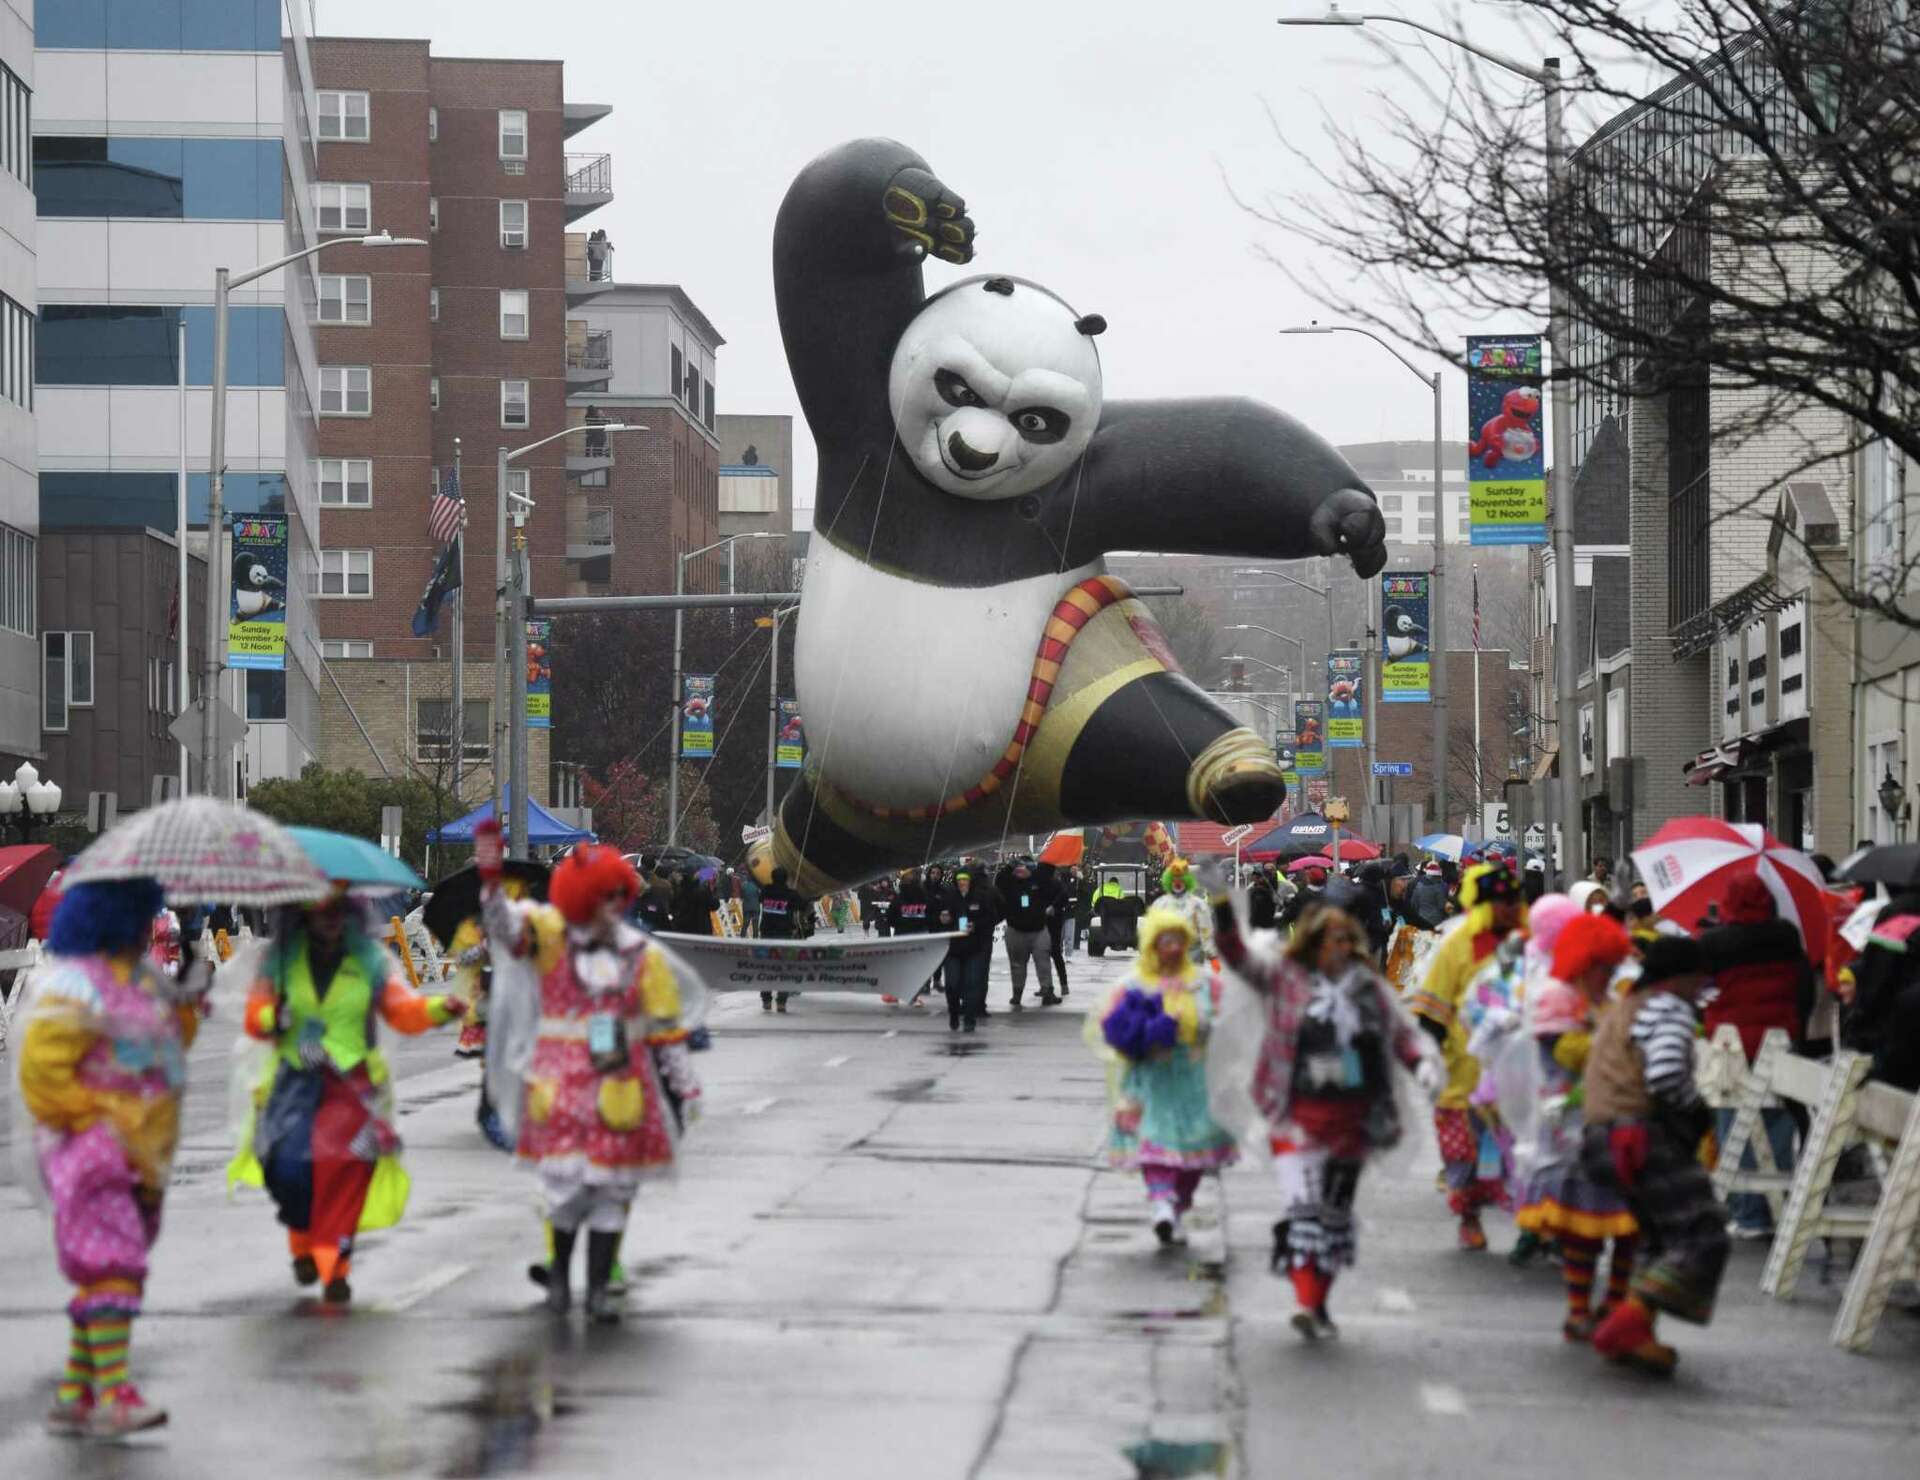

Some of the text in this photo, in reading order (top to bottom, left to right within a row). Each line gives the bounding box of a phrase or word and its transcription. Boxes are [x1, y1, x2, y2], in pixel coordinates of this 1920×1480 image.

[1485, 487, 1526, 497] Sunday
[1471, 498, 1543, 508] November 24
[1485, 510, 1529, 519] 12 Noon
[241, 625, 271, 635] Sunday
[230, 634, 271, 642] November
[1392, 665, 1417, 673] Sunday
[1374, 763, 1400, 776] Spring
[1290, 825, 1327, 834] GIANTS
[736, 960, 782, 972] Kung
[812, 963, 867, 971] Panda
[729, 971, 878, 987] City Carting & Recycling
